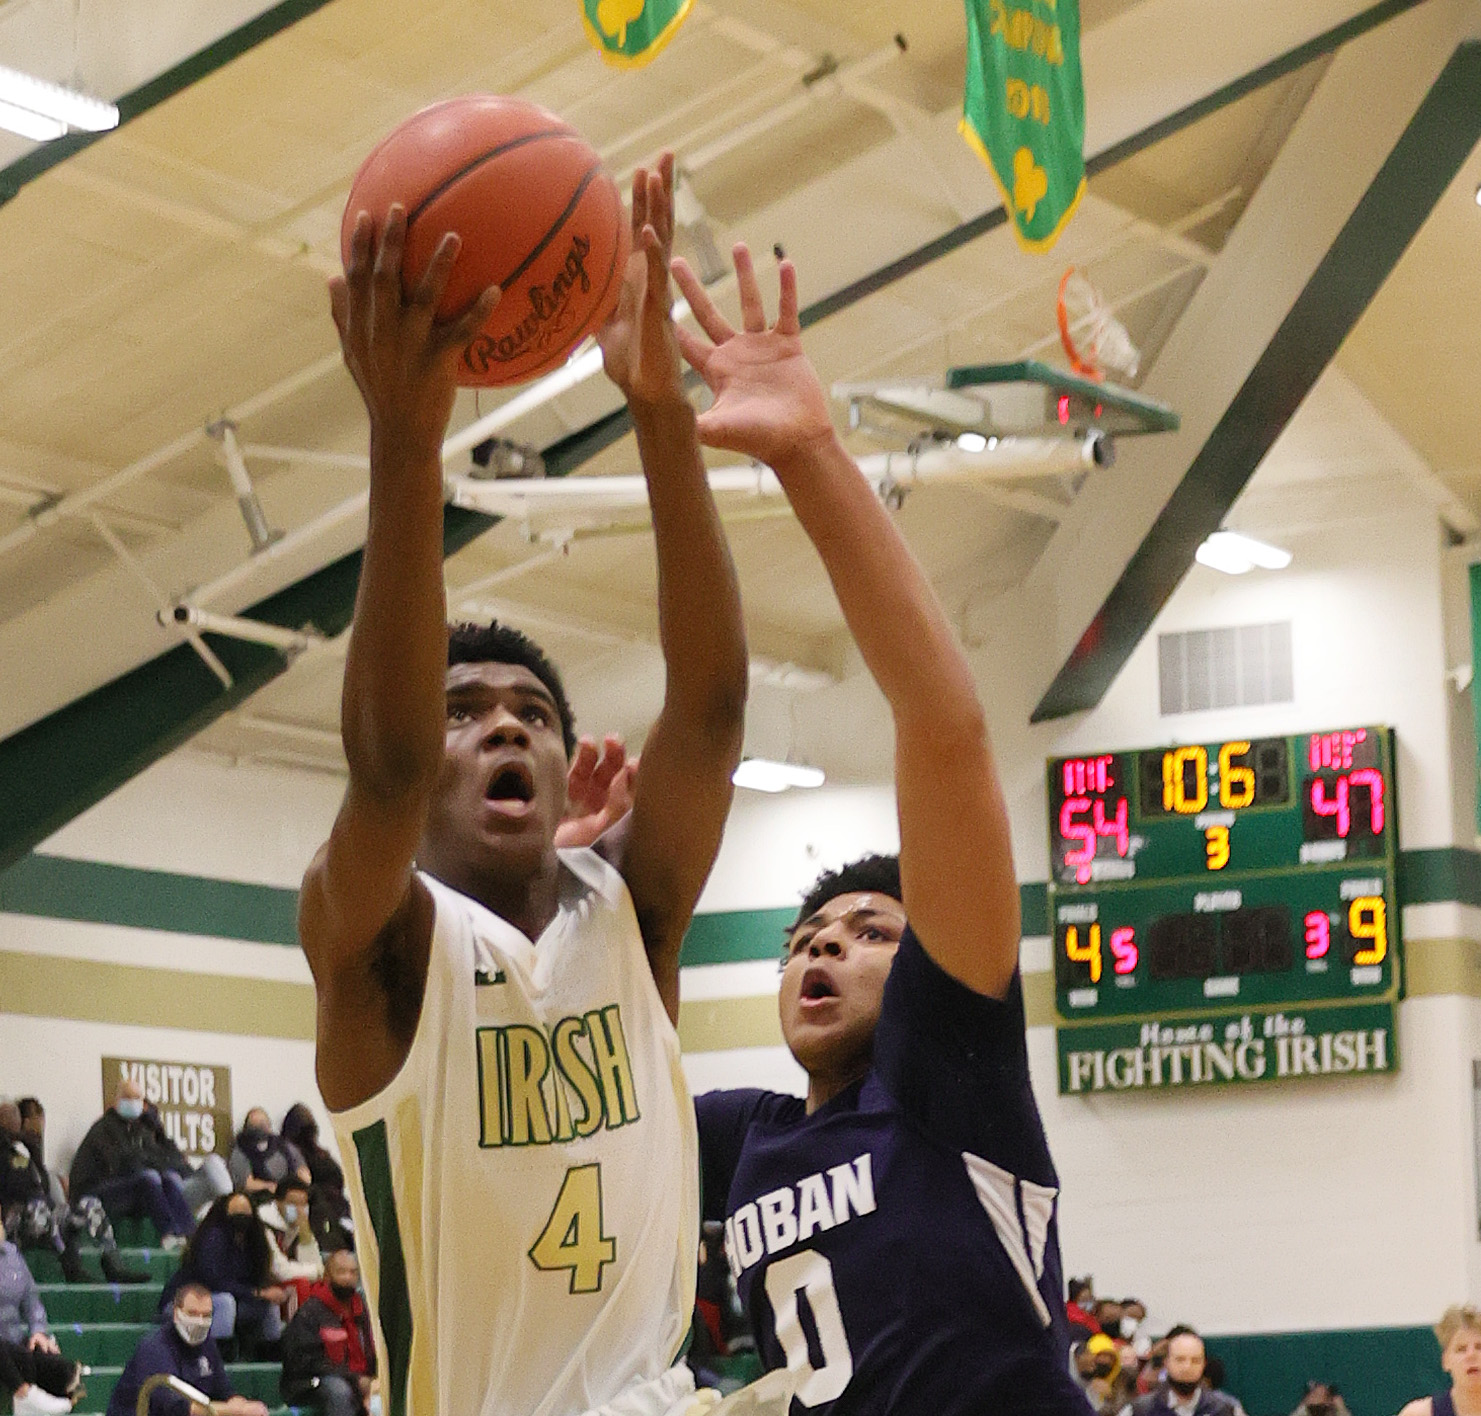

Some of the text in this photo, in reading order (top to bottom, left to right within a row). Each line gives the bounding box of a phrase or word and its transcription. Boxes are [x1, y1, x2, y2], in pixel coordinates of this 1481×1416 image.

[464, 234, 590, 374] Rawlings
[1060, 796, 1129, 866] 54
[1311, 767, 1385, 838] 47
[1205, 825, 1231, 871] 3
[1065, 922, 1102, 983] 4
[1110, 926, 1139, 975] 5
[1304, 909, 1330, 960] 3
[1348, 896, 1387, 966] 9
[1068, 1028, 1388, 1091] FIGHTING IRISH
[1140, 1012, 1306, 1048] Home of the
[475, 1003, 641, 1149] IRISH
[528, 1162, 616, 1296] 4
[724, 1152, 878, 1279] HOBAN
[764, 1248, 854, 1409] 0
